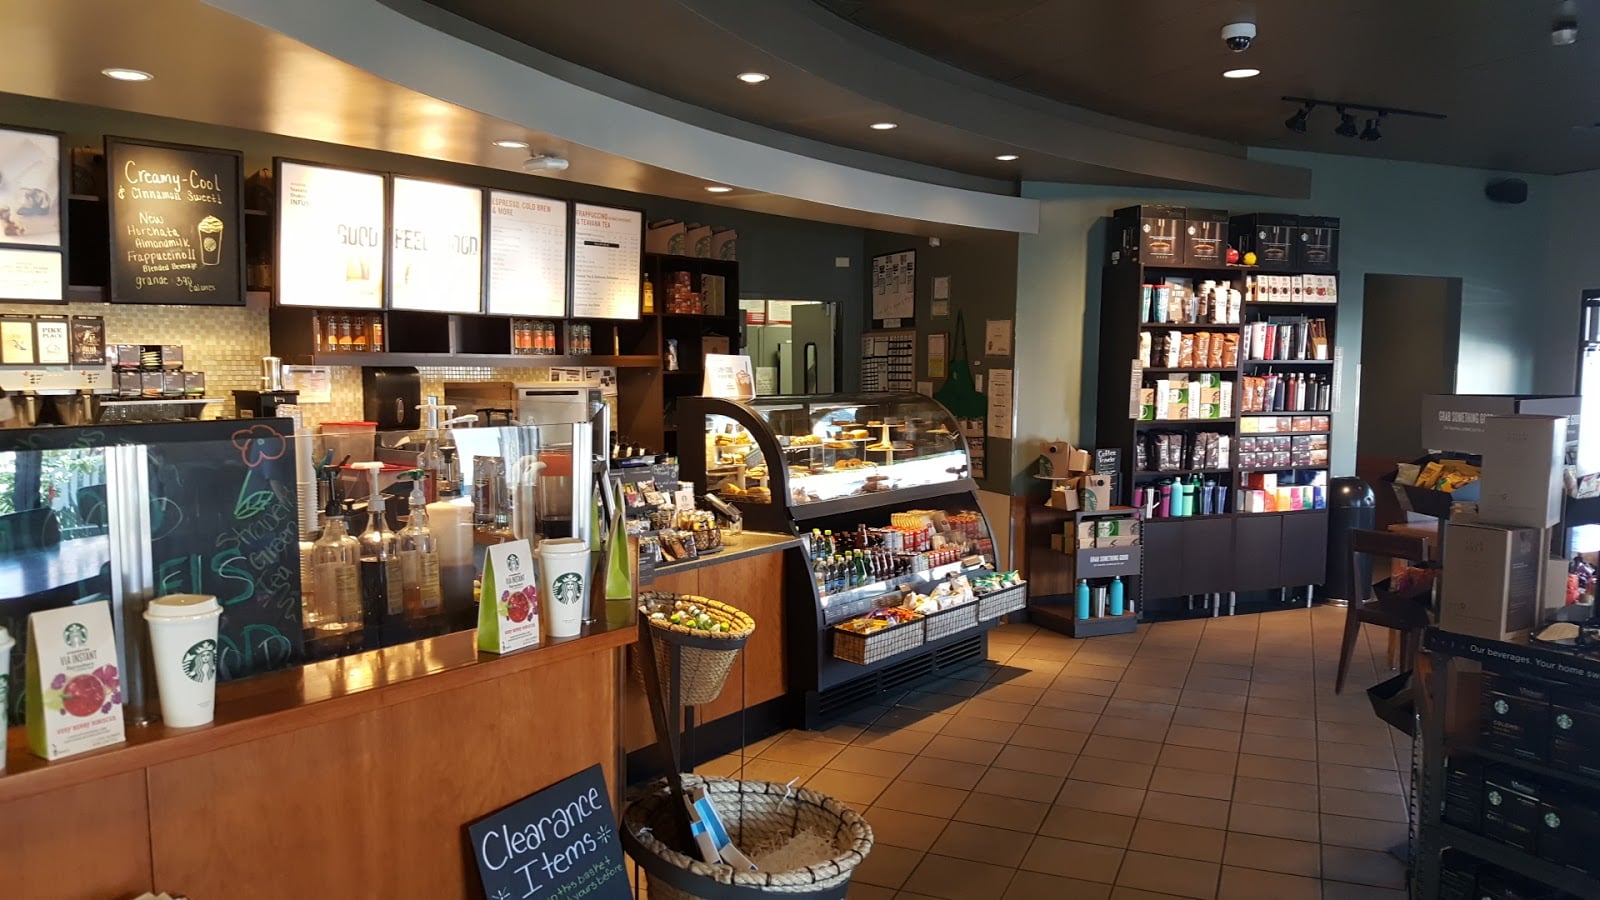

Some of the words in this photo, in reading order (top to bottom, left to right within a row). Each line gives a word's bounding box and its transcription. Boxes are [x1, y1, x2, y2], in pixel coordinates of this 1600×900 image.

[126, 224, 181, 238] Horchata
[72, 650, 97, 664] INSTANT
[1470, 643, 1486, 653] Our
[1487, 647, 1533, 664] beverages.
[1535, 658, 1557, 671] Your
[1558, 664, 1585, 677] home
[482, 787, 603, 871] Clearance
[512, 832, 598, 899] Items
